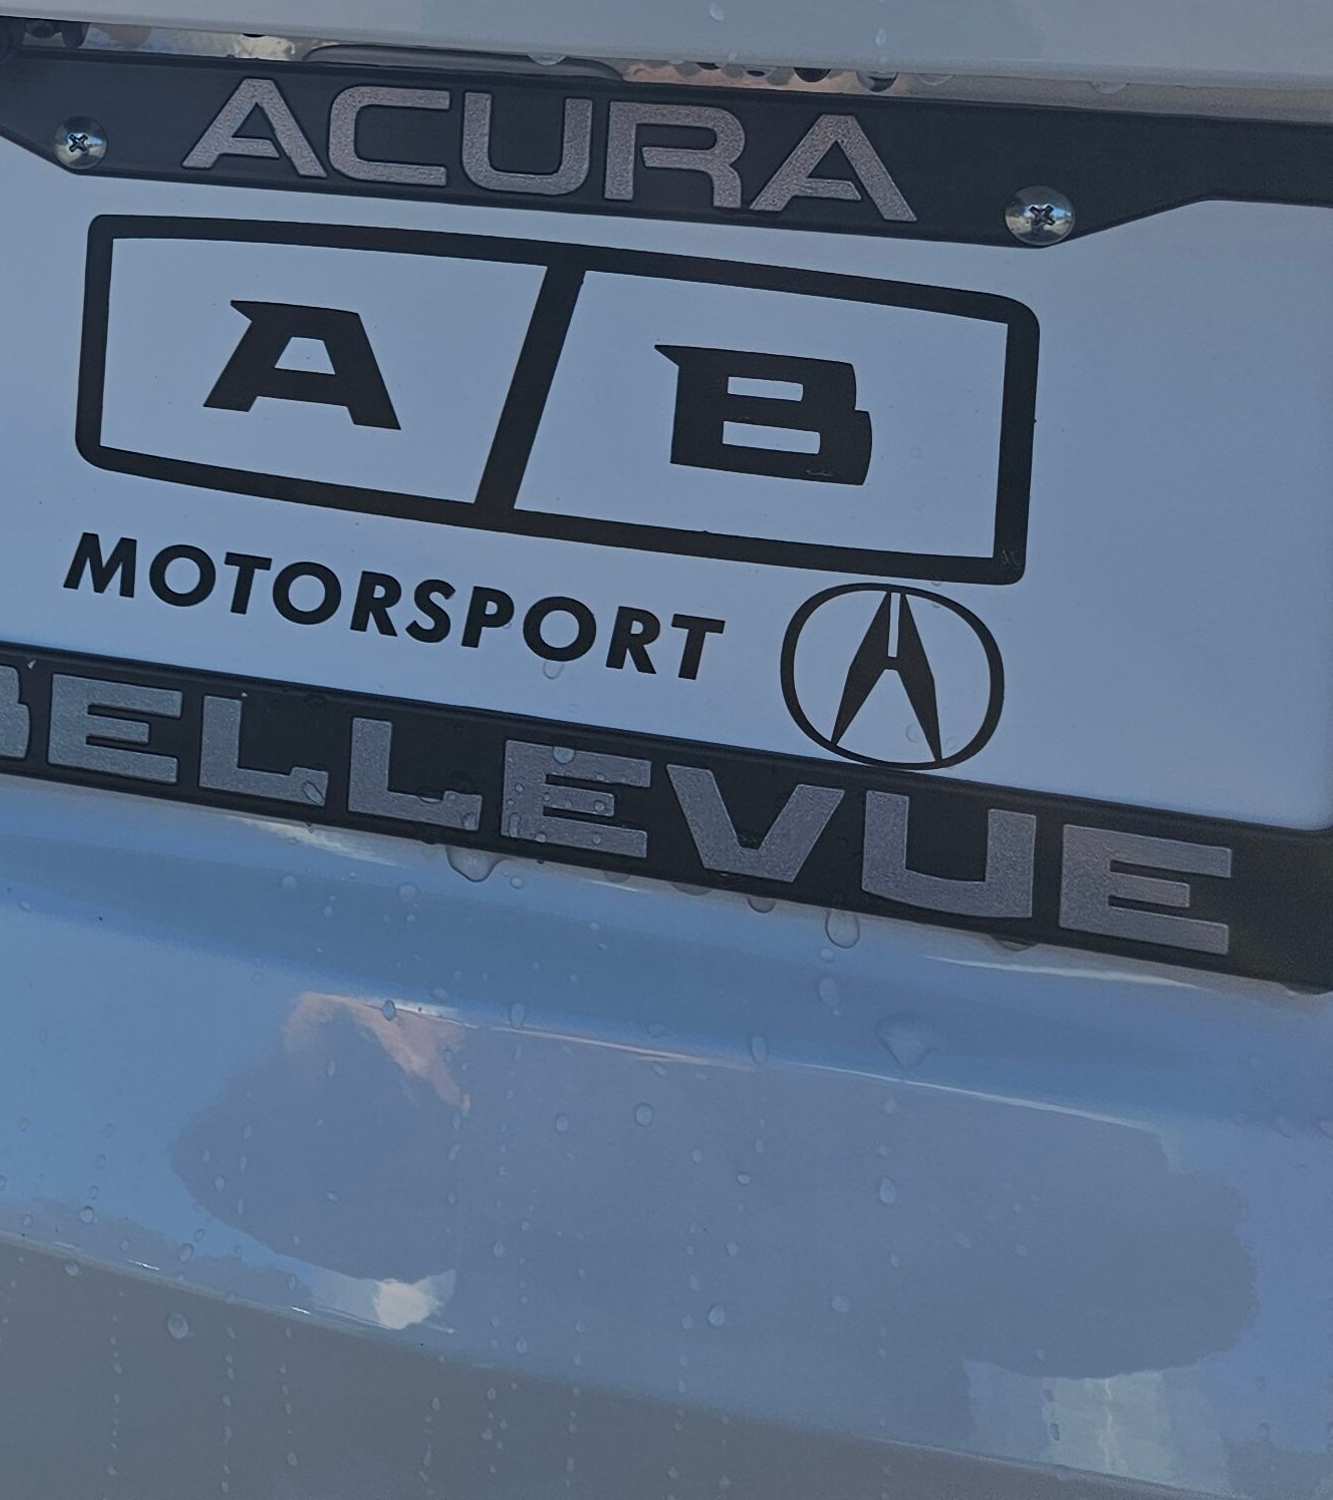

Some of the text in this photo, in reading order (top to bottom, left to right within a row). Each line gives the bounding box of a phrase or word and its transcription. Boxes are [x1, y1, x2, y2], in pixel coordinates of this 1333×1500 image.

[181, 76, 917, 222] ACURA
[202, 299, 873, 487] A B
[63, 532, 725, 681] MOTORSPORT
